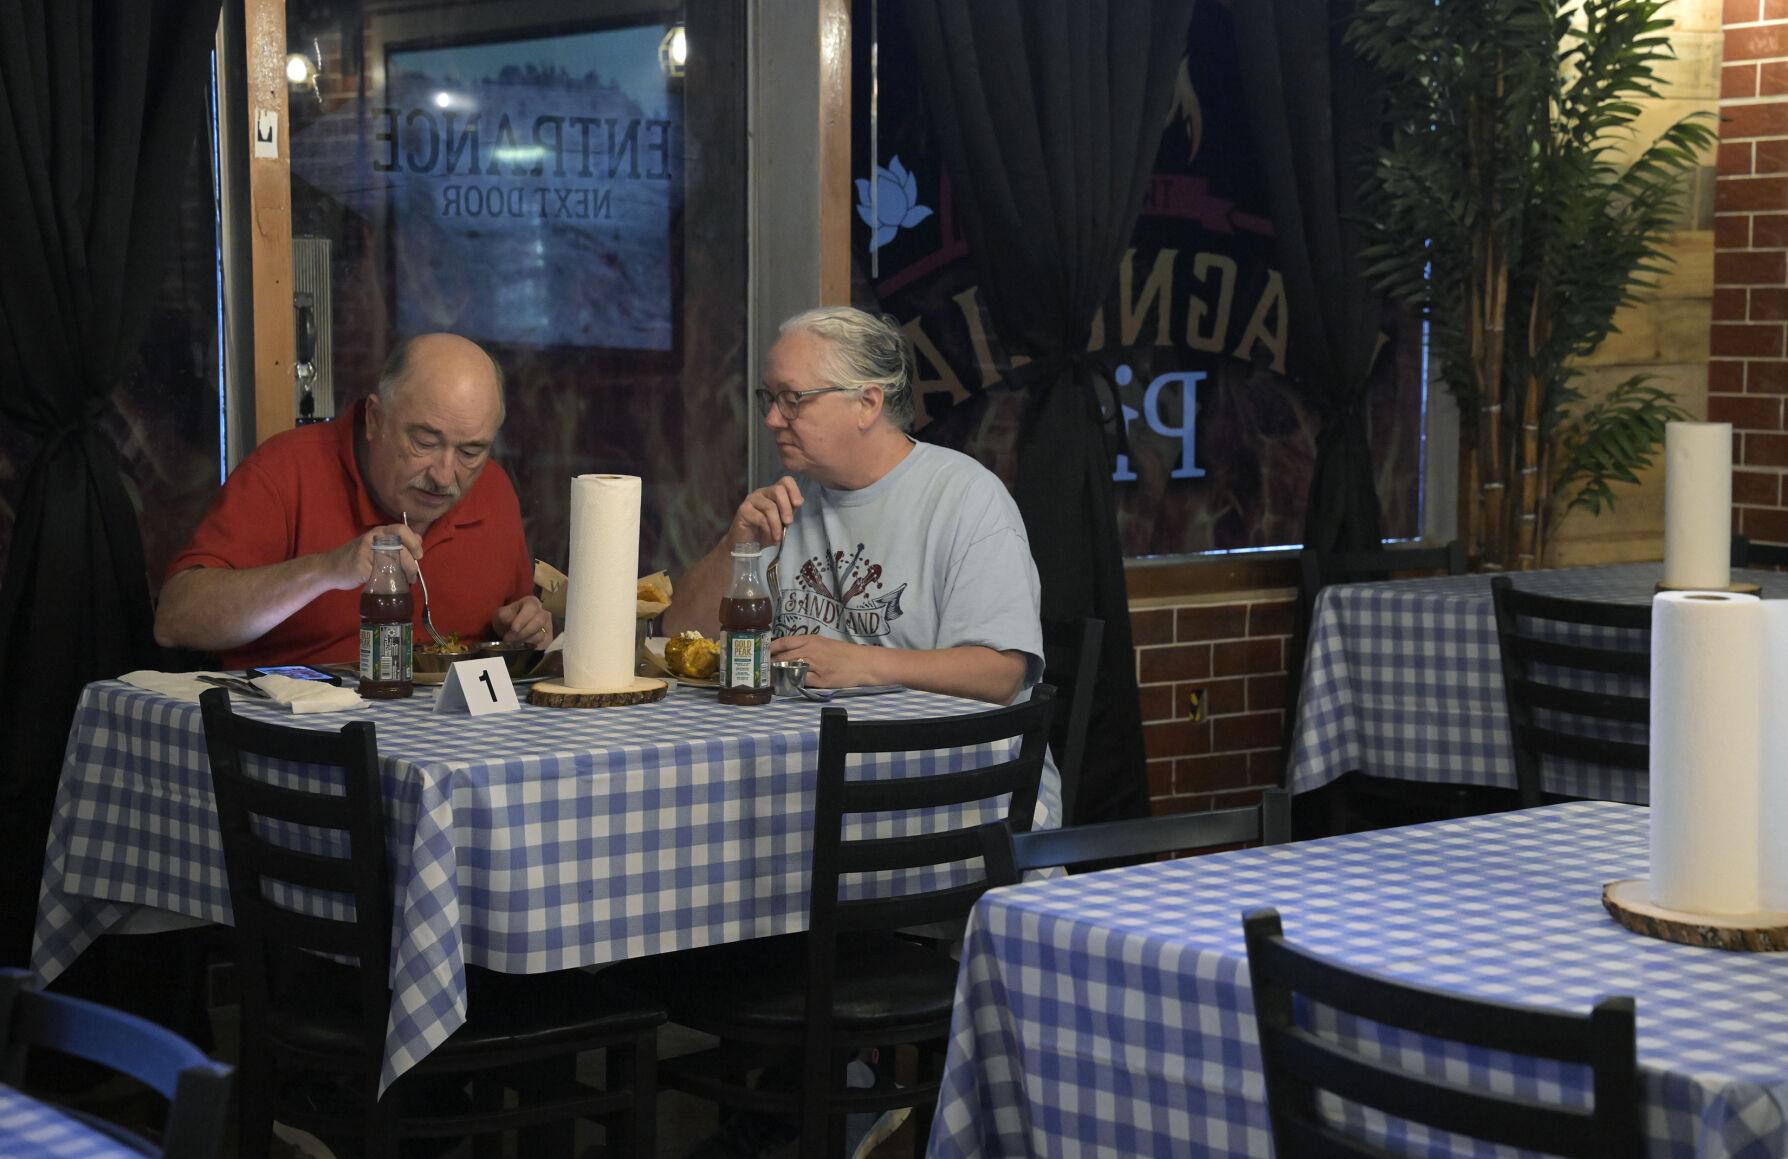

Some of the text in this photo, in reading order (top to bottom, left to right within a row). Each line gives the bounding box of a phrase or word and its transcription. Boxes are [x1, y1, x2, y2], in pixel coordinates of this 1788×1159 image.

[784, 591, 881, 634] SANDYAND
[735, 639, 752, 648] GOLD
[735, 648, 752, 656] PEAK
[478, 669, 498, 703] 1
